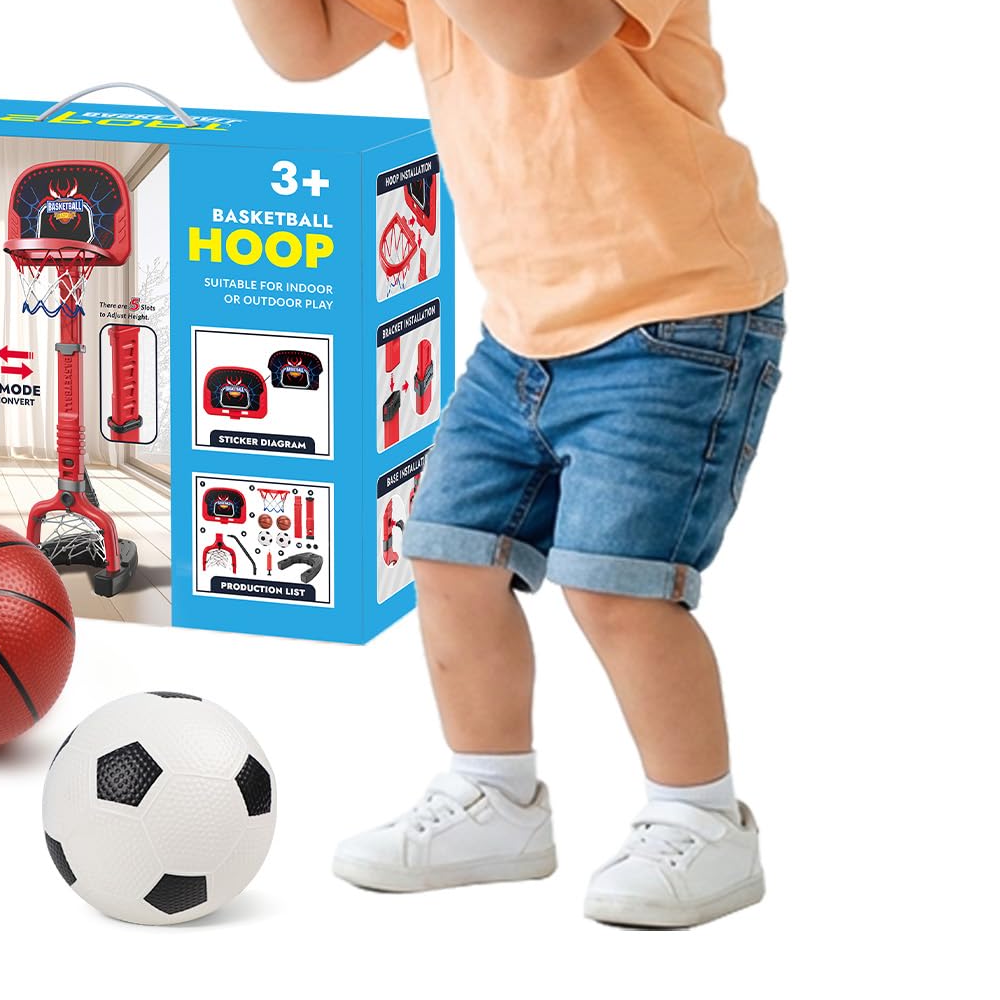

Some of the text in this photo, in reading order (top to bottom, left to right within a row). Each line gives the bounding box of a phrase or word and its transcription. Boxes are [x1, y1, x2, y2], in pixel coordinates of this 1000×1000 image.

[270, 160, 330, 197] 3+
[385, 161, 432, 187] HOOP INSTALLATION
[48, 202, 82, 211] BASKETBALL
[212, 208, 334, 229] BASKETBALL
[188, 226, 335, 269] HOOP
[204, 277, 334, 295] SUITABLE FOR INDOOR
[100, 301, 117, 309] There
[130, 297, 141, 312] 5
[140, 304, 156, 312] Slots
[224, 294, 334, 310] OR OUTDOOR PLAY
[382, 304, 436, 340] BRACKET INSTALLATION
[218, 435, 307, 450] STICKER DIAGRAM
[386, 456, 426, 488] BASE INSTALLATI
[220, 581, 306, 597] PRODUCTION LIST
